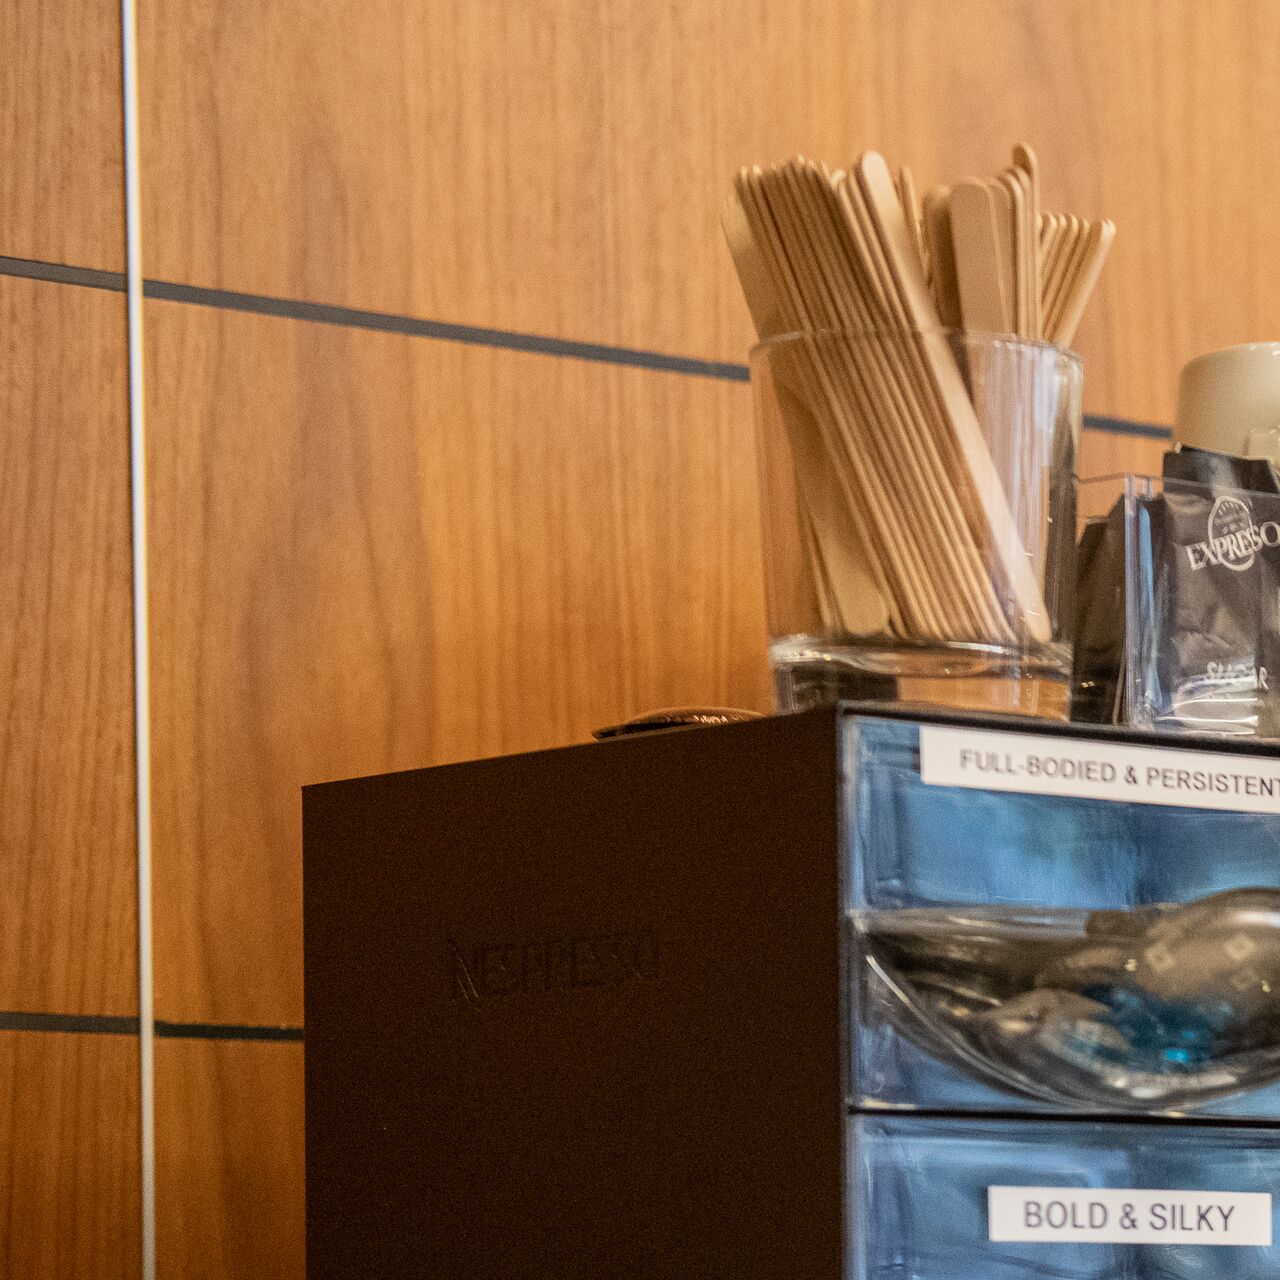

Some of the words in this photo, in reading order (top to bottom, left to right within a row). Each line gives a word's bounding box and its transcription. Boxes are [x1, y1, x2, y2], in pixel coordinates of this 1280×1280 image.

[959, 748, 1117, 784] FULL-BODIED
[1124, 765, 1139, 785] &
[1024, 1200, 1109, 1229] BOLD
[1119, 1203, 1138, 1230] &
[1149, 1202, 1235, 1232] SILKY
